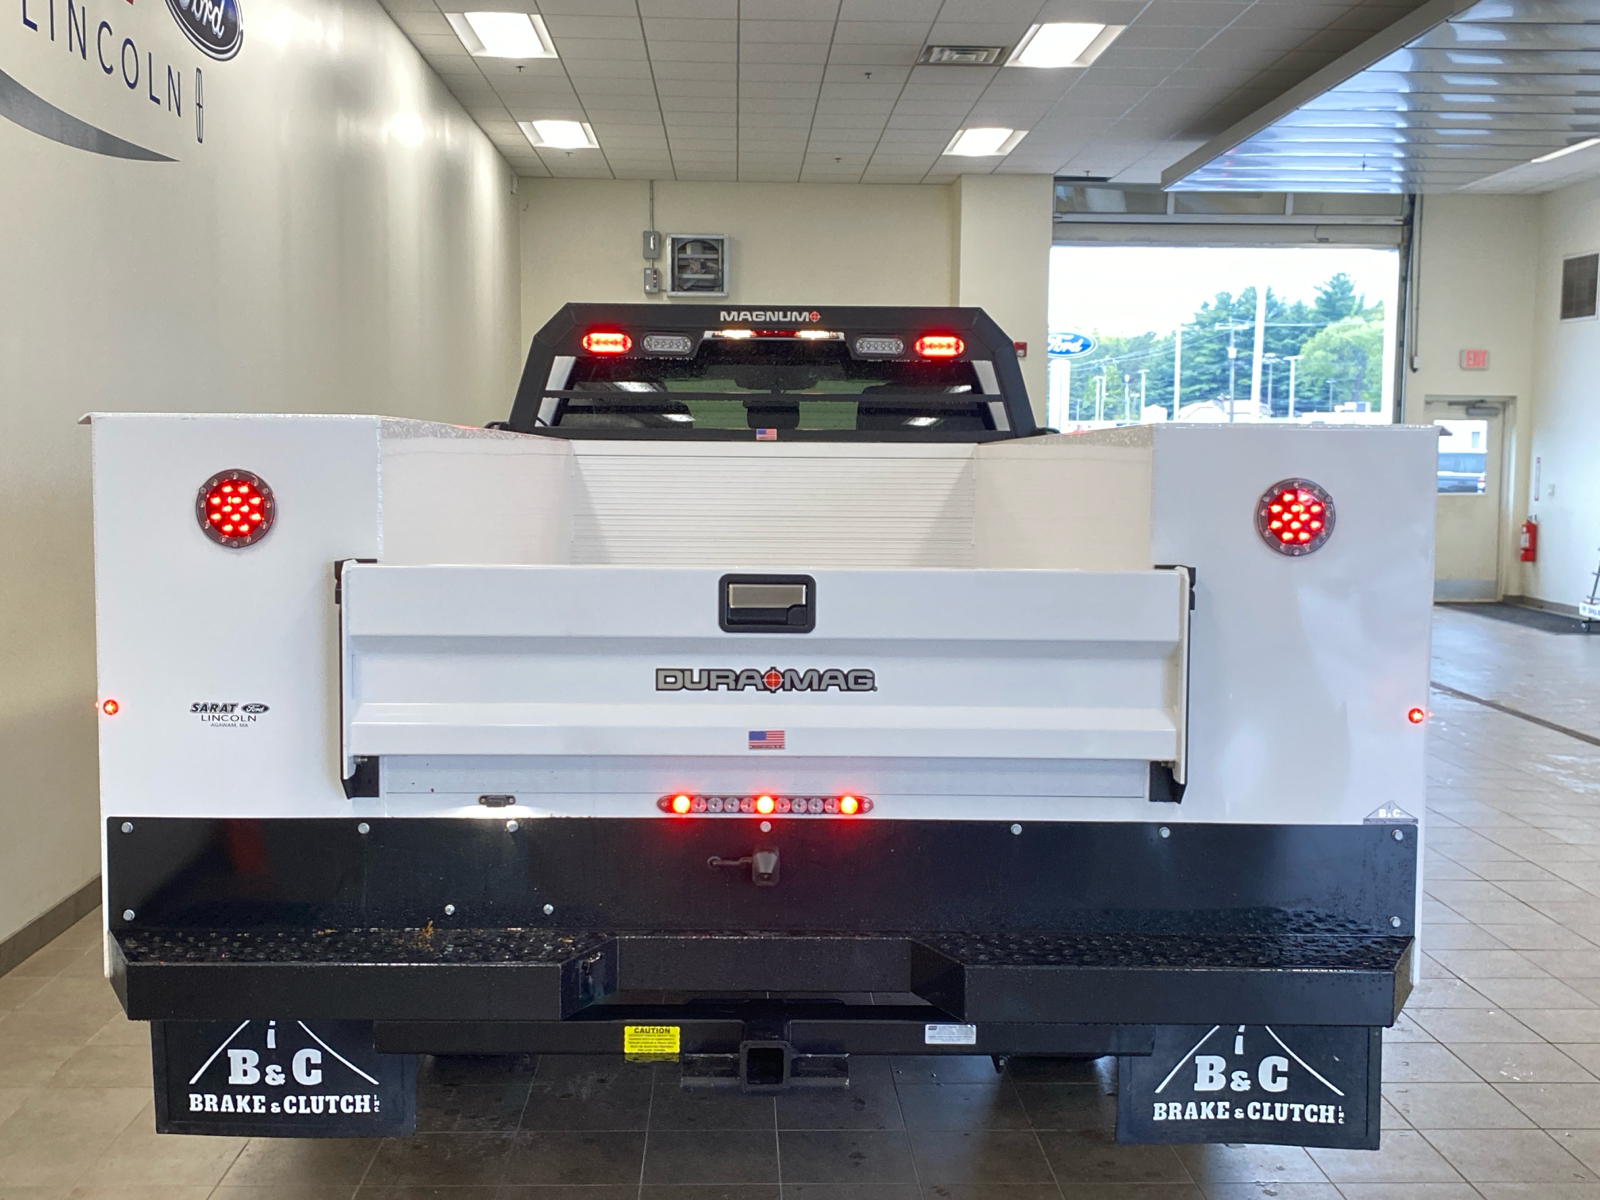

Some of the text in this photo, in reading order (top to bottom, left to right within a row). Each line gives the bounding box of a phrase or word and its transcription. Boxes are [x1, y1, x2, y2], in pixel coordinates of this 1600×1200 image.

[720, 311, 810, 322] MAGNUM
[1048, 332, 1084, 352] Ford
[190, 702, 268, 713] SARAT Ford
[201, 714, 257, 722] LINCOLN
[189, 1094, 266, 1113] BRAKE
[270, 1102, 282, 1113] &
[284, 1095, 371, 1114] CLUTCH
[1152, 1102, 1230, 1120] BRAKE
[1234, 1109, 1245, 1119] &
[1247, 1102, 1336, 1124] CLUTCH
